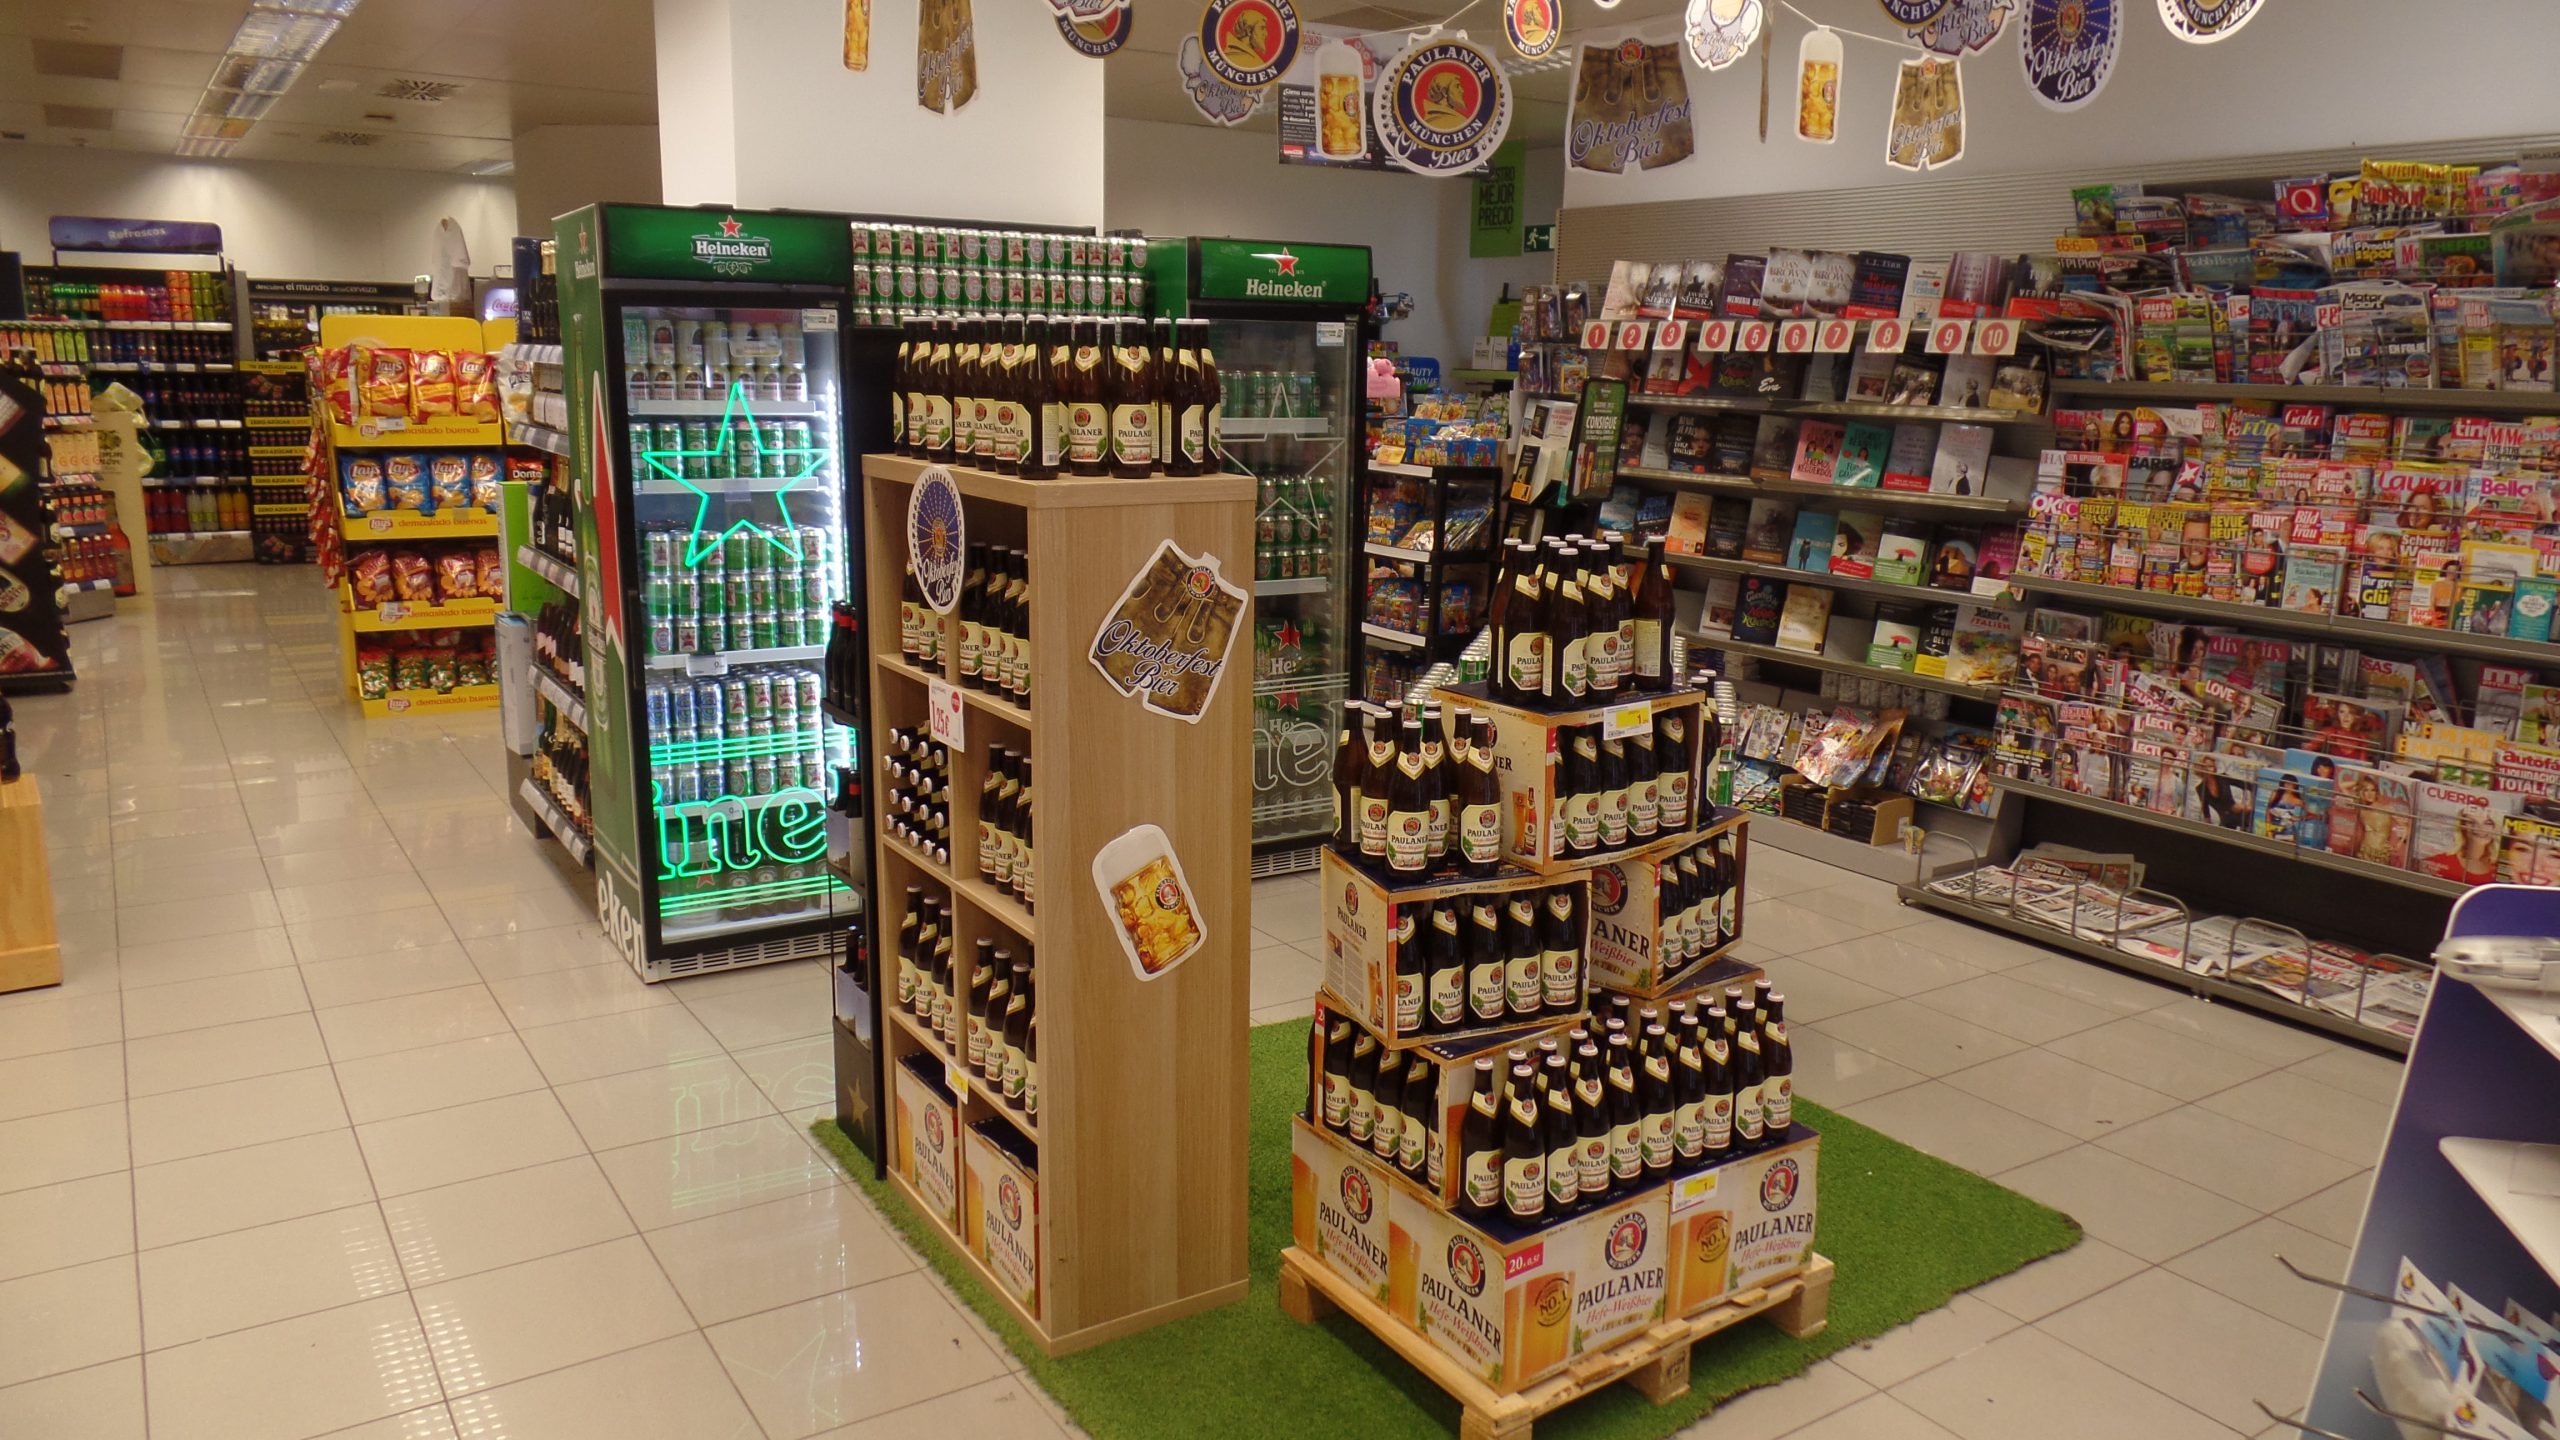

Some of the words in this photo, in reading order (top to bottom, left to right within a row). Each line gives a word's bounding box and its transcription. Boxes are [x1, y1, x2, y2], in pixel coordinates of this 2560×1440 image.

[1517, 27, 1558, 56] MÜNCHEN
[1208, 48, 1279, 84] MÜNCHEN
[1402, 45, 1492, 86] PAULANER
[2055, 69, 2091, 101] Bier
[1408, 117, 1484, 148] MÜNCHEN
[1569, 96, 1692, 161] Oktoberfest
[1890, 107, 1963, 157] Oktoberfest
[1428, 147, 1474, 169] Bier
[1613, 138, 1664, 168] Bier
[1911, 137, 1944, 164] Bier
[1479, 183, 1516, 205] MEJOR
[2291, 188, 2318, 213] Q
[1478, 206, 1515, 226] PRECIO
[107, 227, 168, 241] Refrescos
[695, 240, 769, 258] Heineken
[2214, 254, 2251, 265] Report
[1814, 271, 1854, 281] BROWN
[285, 281, 295, 292] el
[295, 283, 330, 293] mundo
[1246, 279, 1323, 299] Heineken
[1682, 296, 1714, 308] SIERRA
[2343, 292, 2384, 302] Motor
[1592, 329, 1600, 342] 1
[1628, 330, 1637, 342] 2
[1667, 328, 1676, 341] 3
[1711, 329, 1720, 342] 4
[1751, 331, 1760, 344] 5
[1791, 329, 1800, 344] 6
[1832, 328, 1841, 344] 7
[1882, 327, 1893, 344] 8
[1944, 329, 1954, 346] 9
[1987, 329, 2004, 346] 10
[2284, 408, 2321, 427] Gala
[446, 424, 480, 434] buenas
[2129, 457, 2176, 470] BARB
[2224, 466, 2250, 477] Neue
[2224, 477, 2248, 489] Post
[2374, 472, 2464, 496] Laura
[2481, 477, 2534, 497] Bella
[398, 518, 450, 527] demasiado
[453, 516, 488, 527] buenas
[2210, 515, 2246, 528] REVUE
[2295, 510, 2317, 525] Bild
[2210, 527, 2246, 540] HEUTE
[2292, 524, 2317, 539] Frau
[2400, 535, 2446, 547] Schöne
[2362, 588, 2390, 605] Glü
[1097, 620, 1223, 678] Oktoberfest
[1516, 656, 1544, 666] PAULA
[1590, 655, 1619, 665] PAULA
[1125, 660, 1180, 697] Bier
[2205, 679, 2235, 701] LOVE
[2427, 786, 2489, 808] CUERPO
[1632, 803, 1658, 812] PAULA
[1572, 816, 1599, 825] PAULA
[1604, 812, 1627, 821] PAULA
[1337, 905, 1368, 942] PAULANER
[1594, 917, 1650, 960] ANER
[914, 1135, 956, 1196] PAULANER
[1473, 1173, 1499, 1182] PAULA
[1319, 1201, 1389, 1275] PAULANER
[1733, 1211, 1814, 1253] PAULANER
[985, 1209, 1035, 1282] PAULANER
[1576, 1266, 1665, 1315] PAULANER
[1421, 1272, 1502, 1354] PAULANER
